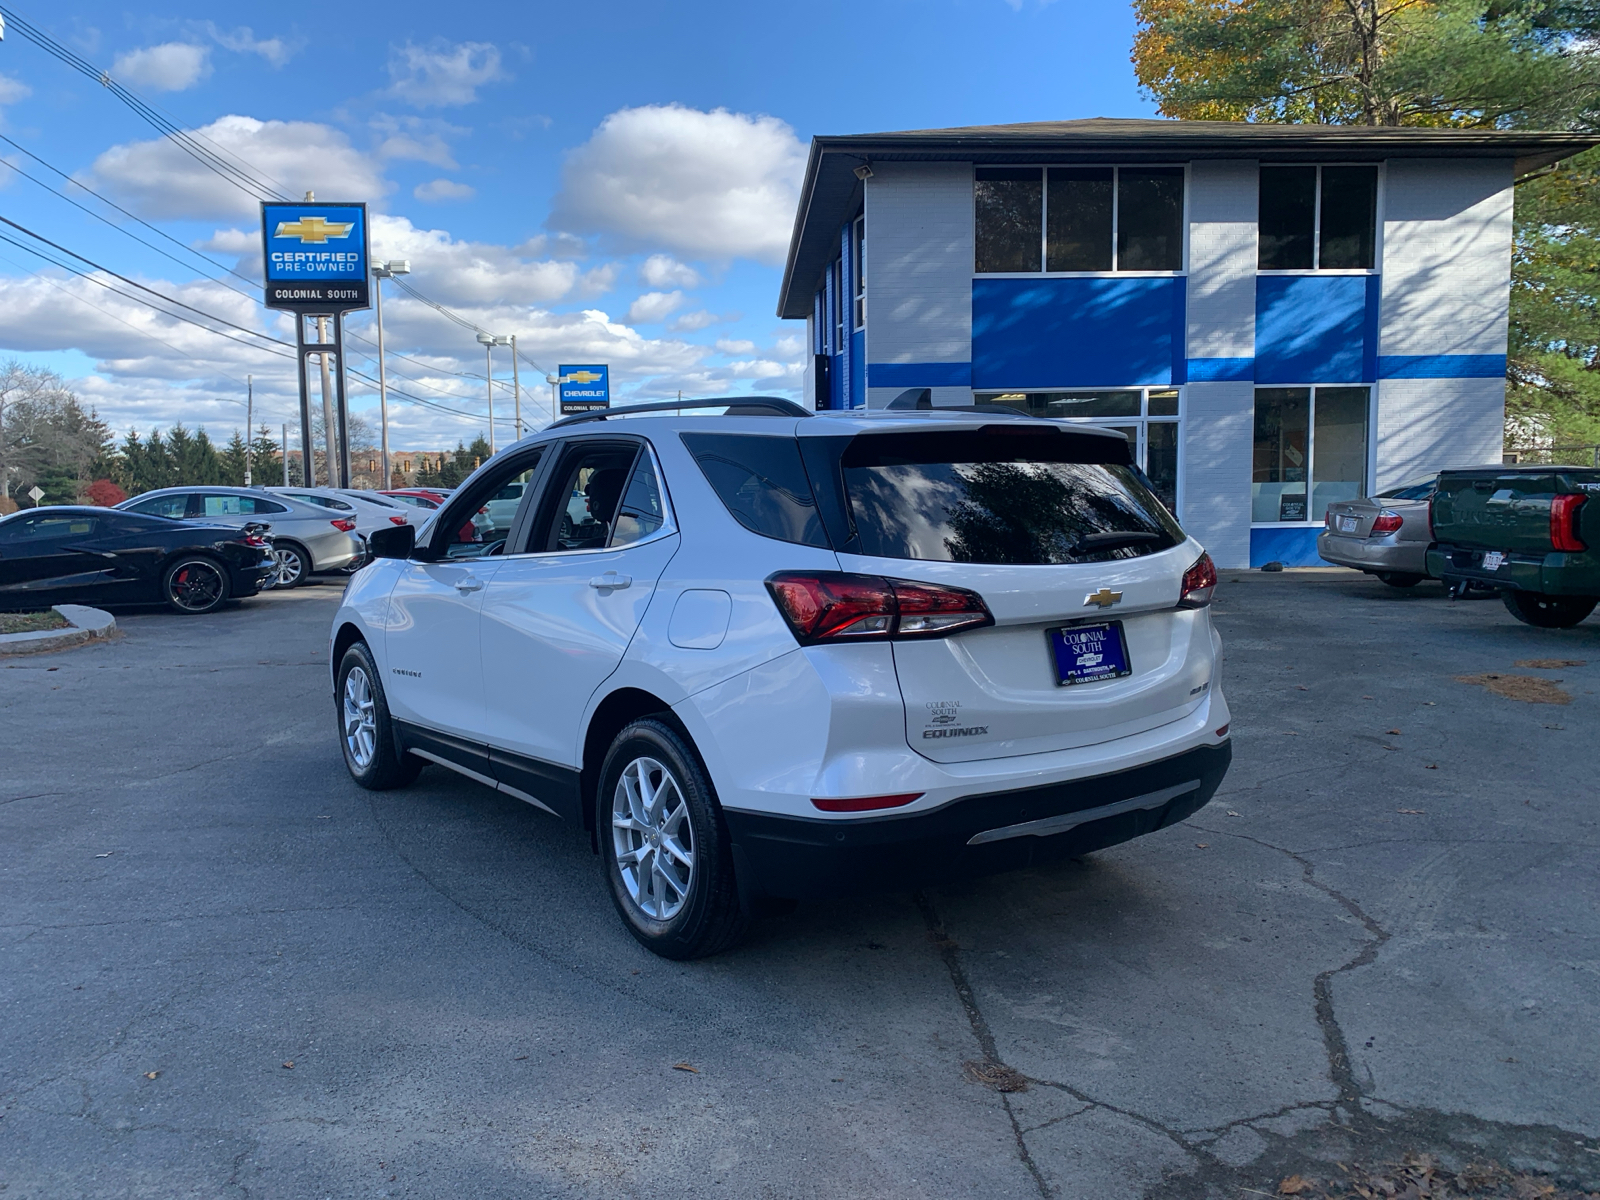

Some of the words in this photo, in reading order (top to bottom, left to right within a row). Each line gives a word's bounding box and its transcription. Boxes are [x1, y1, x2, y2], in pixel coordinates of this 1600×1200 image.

[271, 252, 358, 262] CERTIFIED
[276, 263, 355, 271] PRE-OWNED
[275, 290, 322, 298] COLONIAL
[327, 290, 358, 298] SOUTH
[1577, 483, 1600, 491] TR
[1064, 631, 1106, 645] COLONIAL
[1072, 642, 1102, 654] SOUTH
[926, 701, 962, 709] COLONIAL
[931, 708, 957, 716] SOUTH
[923, 727, 988, 739] EQUINOX
